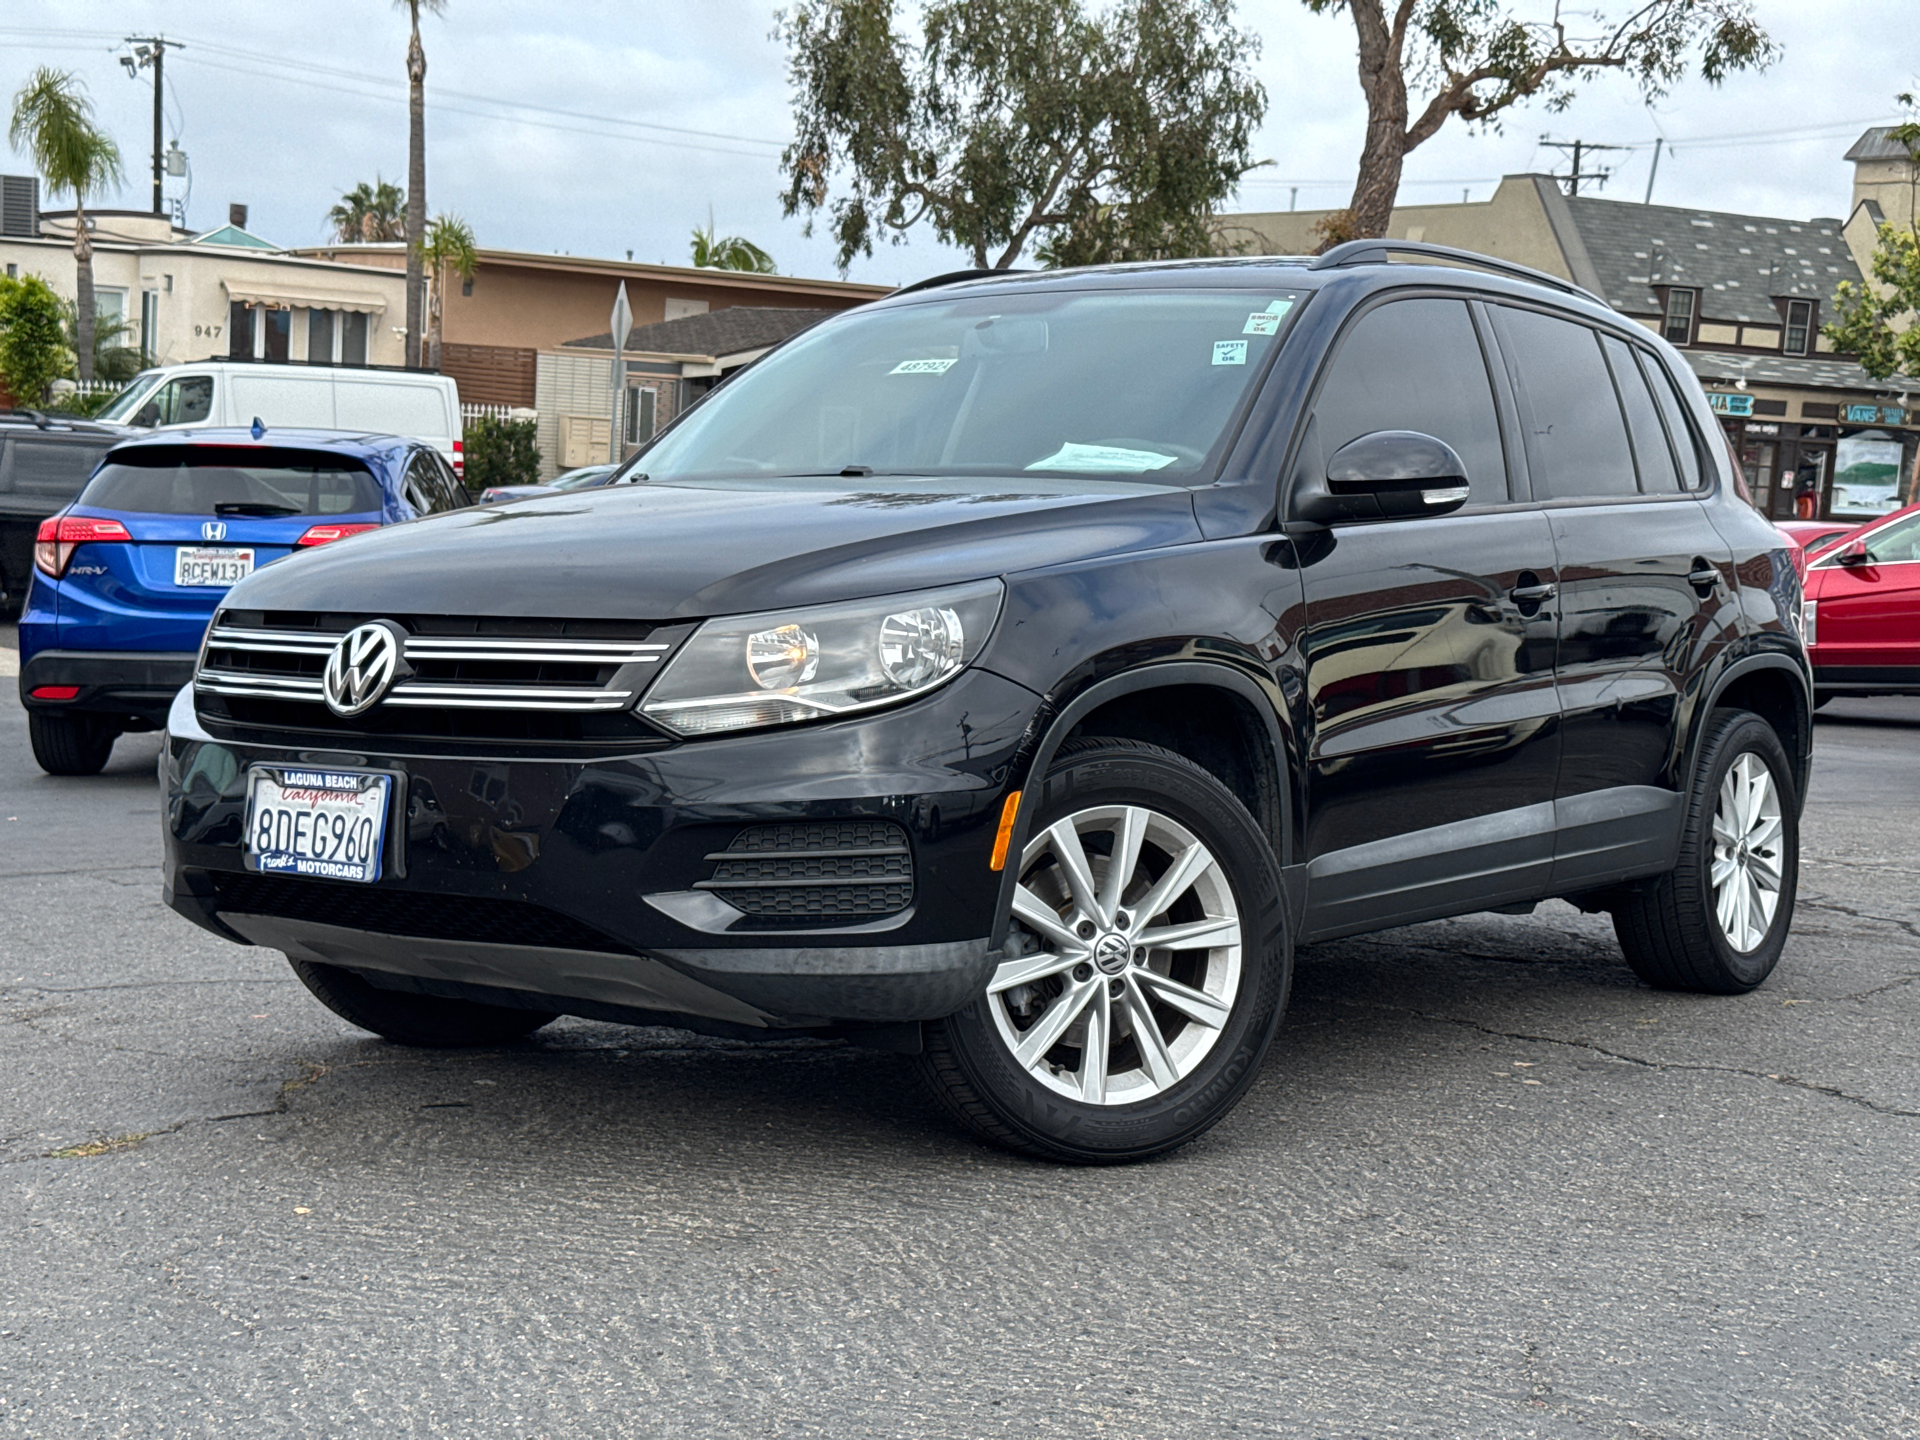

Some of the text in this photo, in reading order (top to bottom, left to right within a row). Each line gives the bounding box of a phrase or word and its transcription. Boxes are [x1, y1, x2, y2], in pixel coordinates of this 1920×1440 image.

[194, 324, 222, 338] 947
[1846, 404, 1878, 423] VANS
[284, 771, 358, 789] LAGUNA BEACH
[281, 787, 364, 809] California
[256, 807, 374, 864] 8DEG960
[259, 852, 364, 880] Frank's MOTORCARS
[1172, 1044, 1255, 1127] KUMHO
